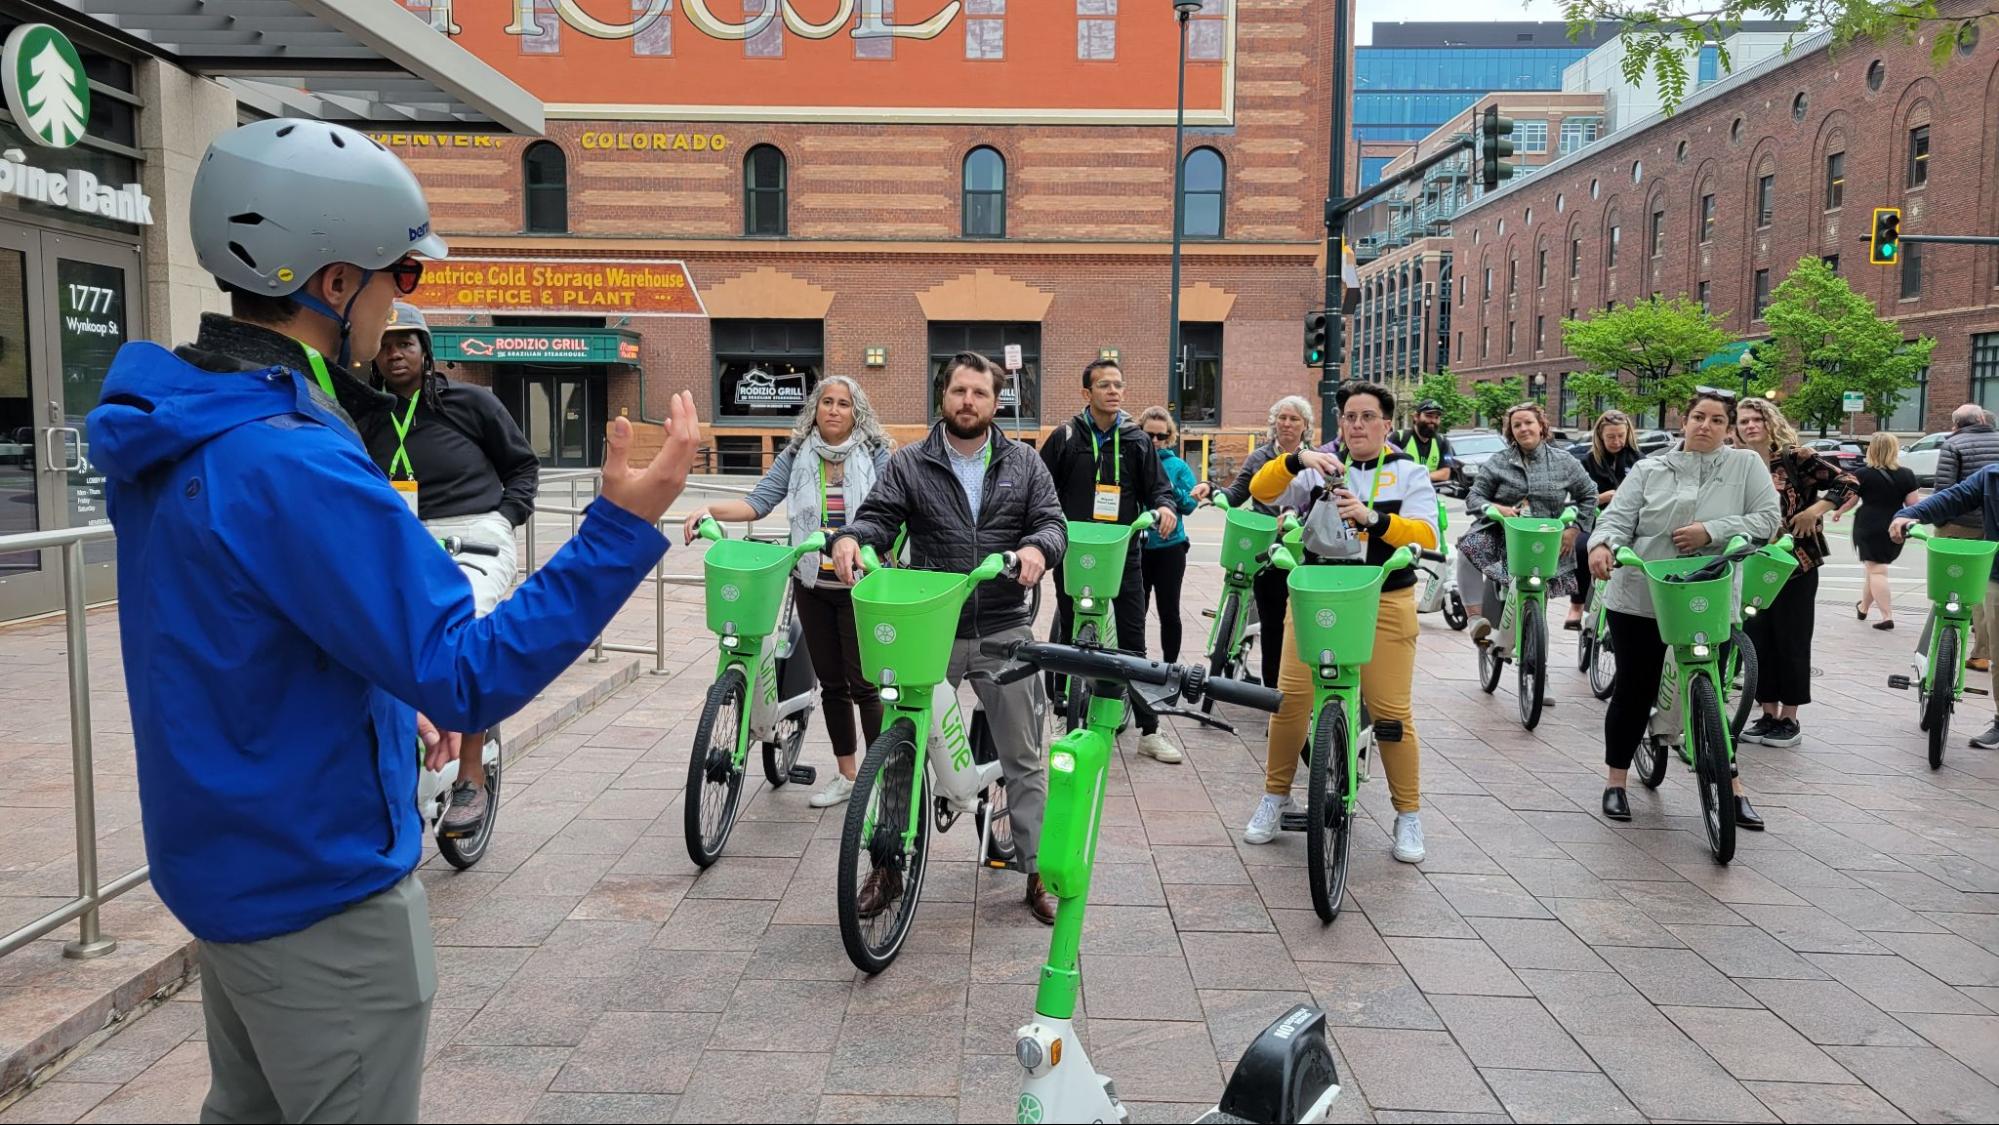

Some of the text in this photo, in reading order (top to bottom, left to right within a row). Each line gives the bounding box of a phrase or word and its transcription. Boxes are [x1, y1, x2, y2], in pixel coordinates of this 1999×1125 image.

[581, 131, 727, 150] COLORADO
[67, 169, 154, 224] Bank
[488, 266, 526, 285] Cold
[532, 267, 602, 289] Storage
[606, 268, 685, 288] Warehouse
[69, 284, 113, 314] 1777
[458, 289, 635, 305] OFFICE & PLANT
[66, 316, 107, 337] Wynkoop
[496, 338, 589, 350] RODIZIO GRILL
[740, 387, 802, 396] RODIZIO GRILL
[1375, 471, 1397, 497] P
[1273, 1024, 1295, 1039] NO
